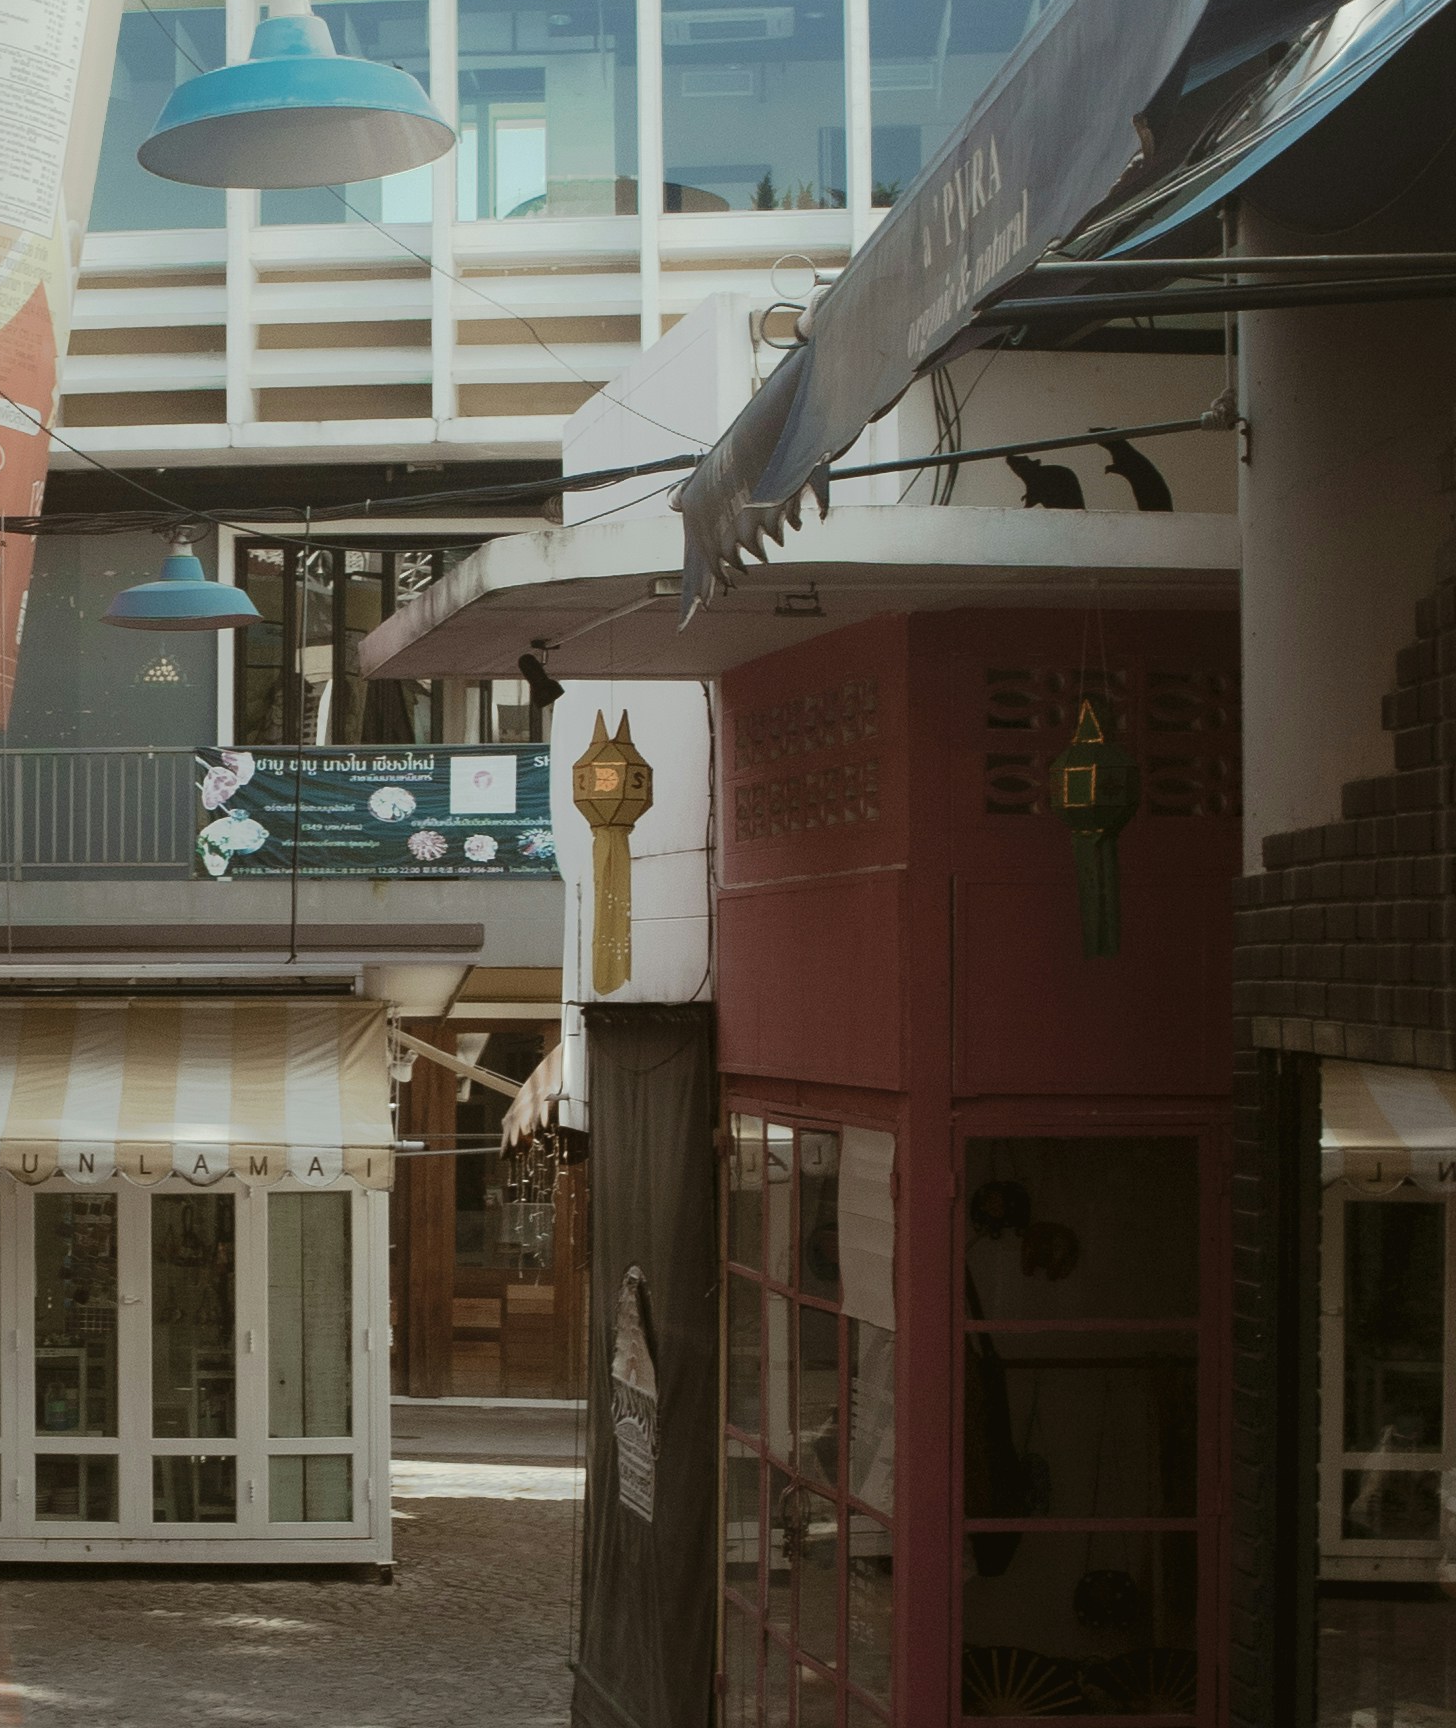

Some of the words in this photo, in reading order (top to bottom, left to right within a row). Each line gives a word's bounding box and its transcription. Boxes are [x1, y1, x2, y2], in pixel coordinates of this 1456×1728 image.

[907, 271, 955, 362] organic
[956, 253, 972, 312] &
[973, 187, 1028, 296] natural
[256, 758, 284, 776] ชาบู
[324, 752, 367, 772] นางใน
[372, 752, 435, 772] เชียงใหม่
